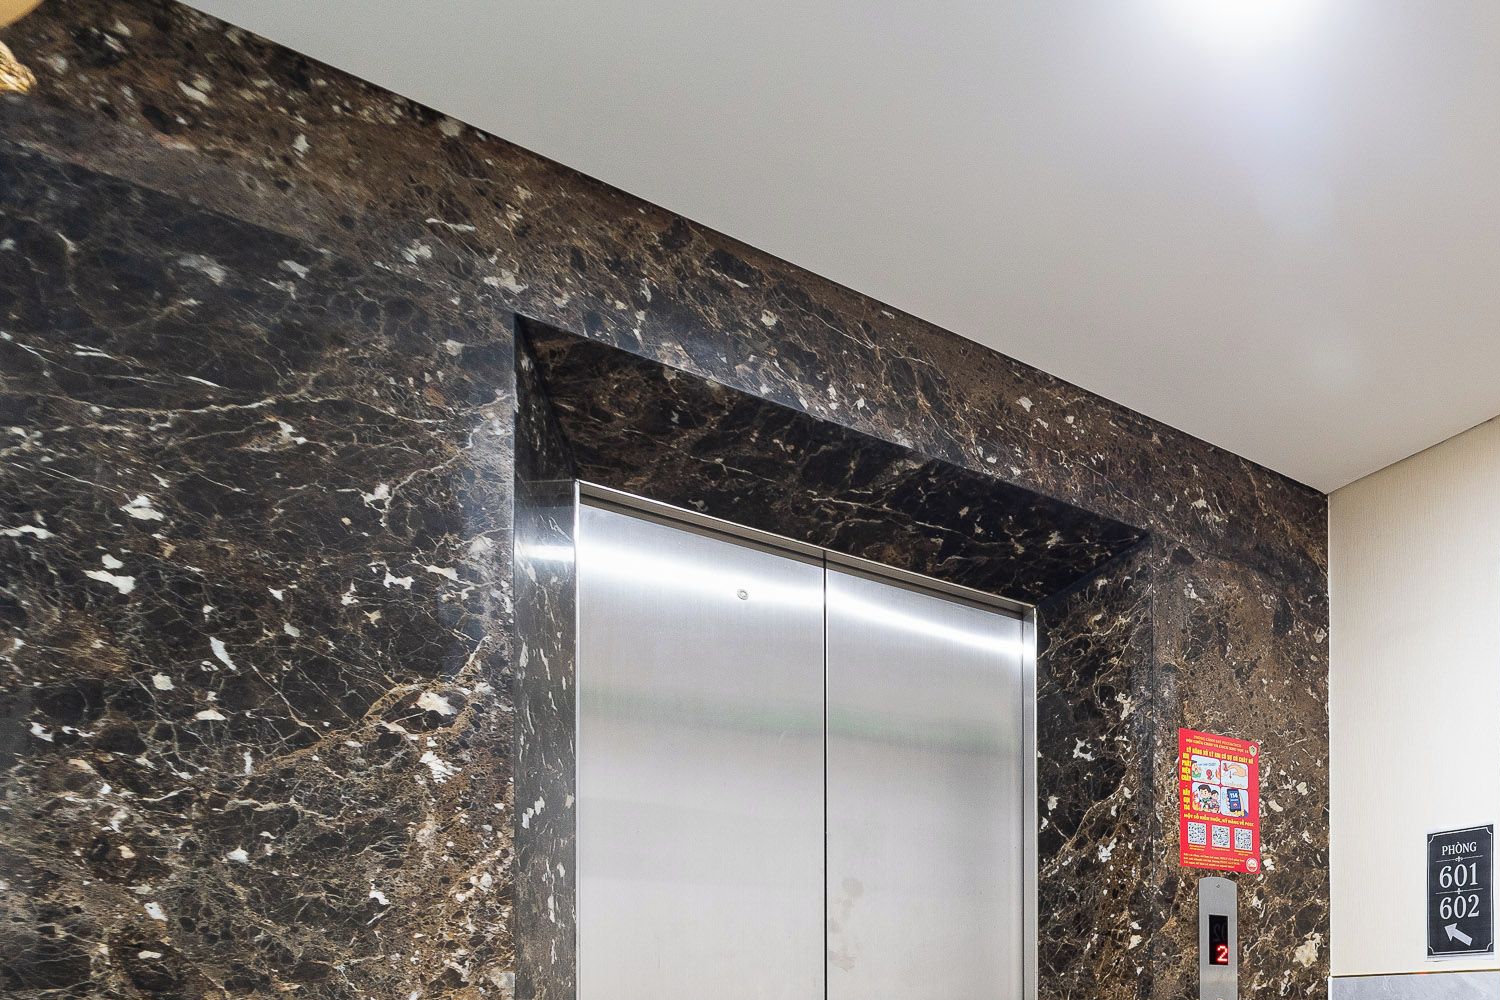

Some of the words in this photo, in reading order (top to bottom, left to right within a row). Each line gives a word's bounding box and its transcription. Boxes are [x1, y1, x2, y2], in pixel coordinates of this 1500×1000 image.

[1441, 842, 1477, 856] PHÒNG
[1439, 862, 1478, 888] 601
[1439, 894, 1480, 920] 602
[1217, 945, 1228, 962] 2
